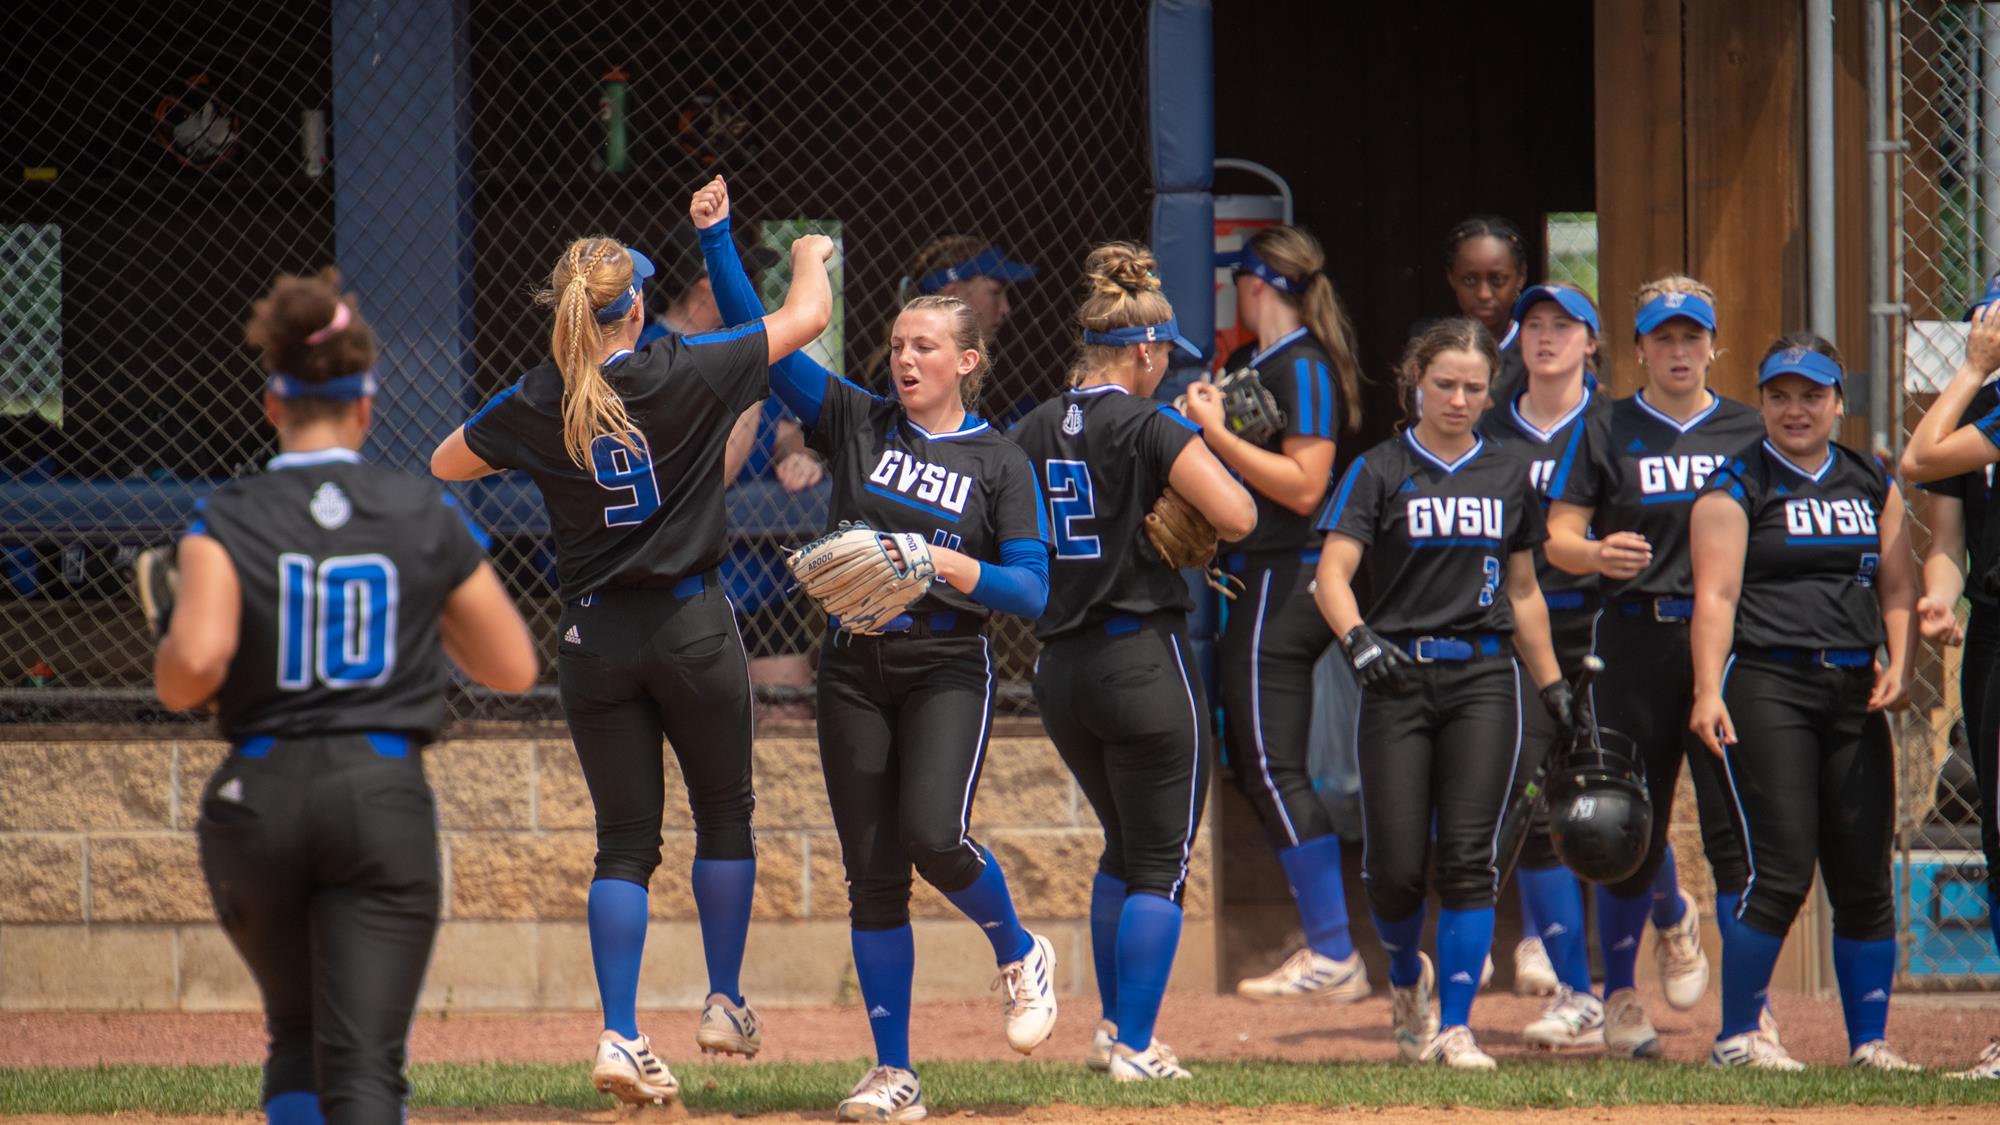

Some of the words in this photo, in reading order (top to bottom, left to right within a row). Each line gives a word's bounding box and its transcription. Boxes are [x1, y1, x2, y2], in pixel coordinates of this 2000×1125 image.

[590, 429, 661, 529] 9
[869, 449, 973, 514] GVSU
[1639, 455, 1726, 495] GVS
[1046, 458, 1102, 560] 2
[1407, 497, 1503, 540] GVSU
[1785, 497, 1878, 536] GVSU
[808, 552, 833, 572] A2000
[1478, 555, 1500, 607] 3
[277, 553, 398, 690] 10
